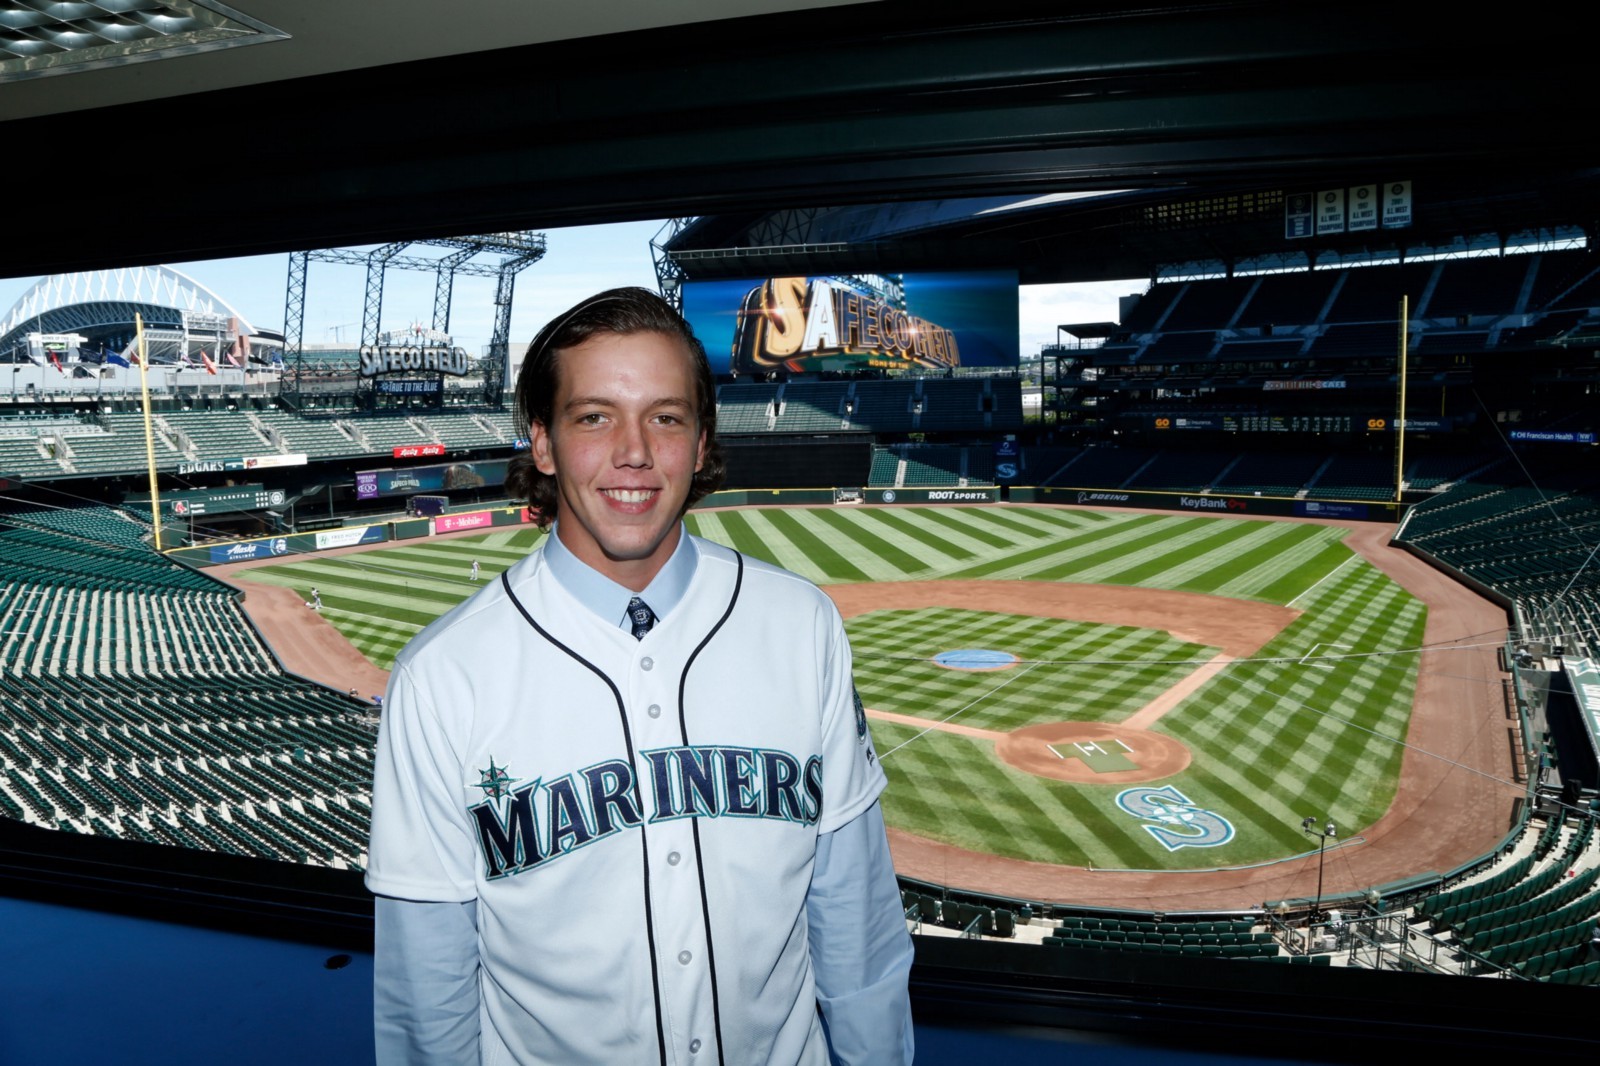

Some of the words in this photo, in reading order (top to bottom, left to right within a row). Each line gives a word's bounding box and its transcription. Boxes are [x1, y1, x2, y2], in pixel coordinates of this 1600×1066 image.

[761, 277, 913, 358] SAFECO
[910, 316, 961, 368] FIELD
[360, 345, 423, 376] SAFECO
[422, 346, 469, 376] FIELD
[1155, 418, 1170, 428] GO
[1367, 418, 1386, 429] GO
[1527, 431, 1554, 440] Franciscan
[1555, 432, 1574, 441] Health
[928, 491, 954, 500] ROOT
[1089, 493, 1129, 501] BOEING
[1180, 496, 1227, 509] KeyBank
[226, 543, 257, 556] Alaska
[466, 744, 823, 882] MARINERS
